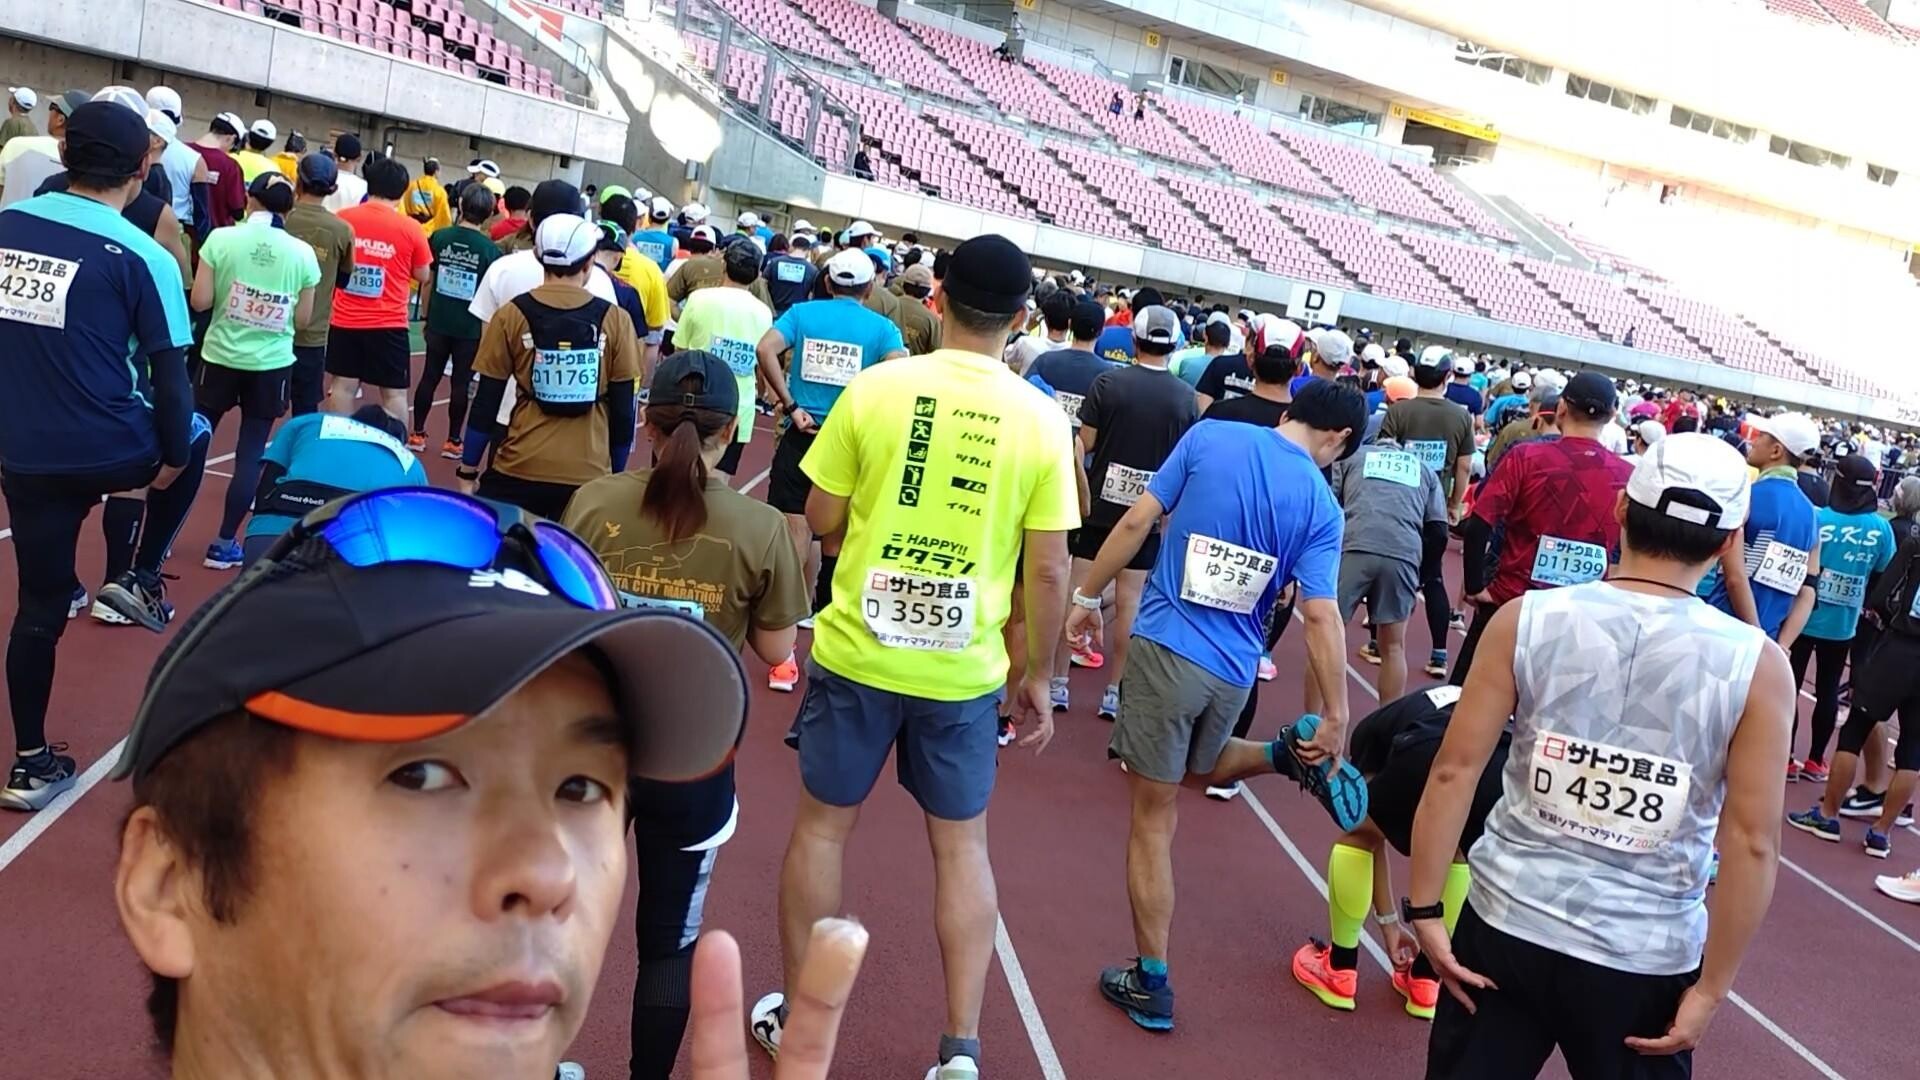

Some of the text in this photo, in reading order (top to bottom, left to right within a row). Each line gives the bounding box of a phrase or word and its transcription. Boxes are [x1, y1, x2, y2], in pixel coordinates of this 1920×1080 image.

[4, 253, 67, 278] サトウ食品
[0, 274, 56, 303] 4238
[353, 275, 383, 288] 1830
[230, 297, 285, 320] D 3472
[1304, 289, 1326, 311] D
[723, 339, 754, 352] サトウ食品
[816, 342, 858, 357] サトウ食品
[544, 352, 596, 365] サトウ食品
[807, 353, 857, 369] たじまさん
[534, 369, 597, 386] D11763
[1061, 395, 1081, 404] サトウ
[1896, 407, 1920, 423] サトウ
[1106, 478, 1146, 496] D 370
[907, 534, 968, 556] HAPPY!!
[1819, 524, 1882, 546] S.K.S
[881, 543, 976, 575] セタラン
[1209, 543, 1273, 573] サトウ食品
[1556, 542, 1602, 558] サトウ食品
[1206, 561, 1252, 586] ゆうま
[1538, 554, 1603, 576] D11399
[1763, 557, 1774, 570] D
[632, 579, 660, 595] CITY
[663, 584, 724, 604] MARATHON
[890, 577, 970, 599] サトウ食品
[867, 599, 963, 628] D 3559
[1568, 743, 1677, 787] サトウ食品
[1534, 767, 1664, 823] D 4328
